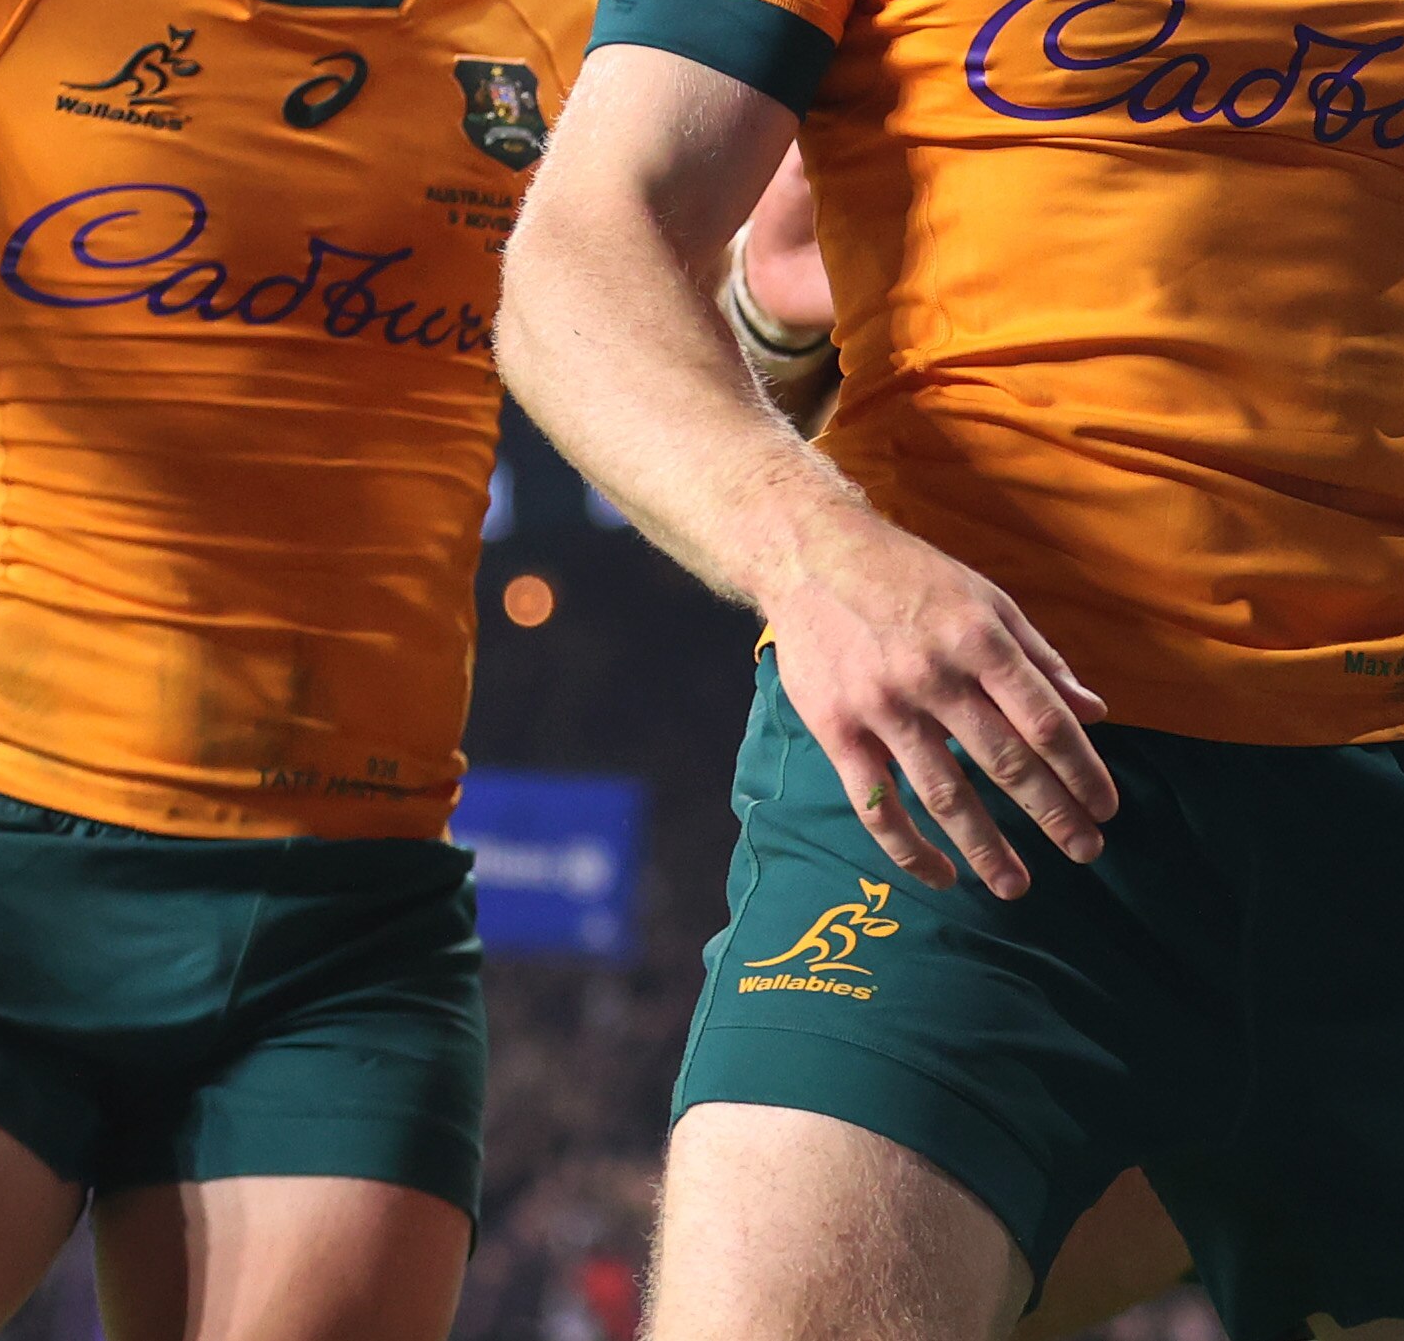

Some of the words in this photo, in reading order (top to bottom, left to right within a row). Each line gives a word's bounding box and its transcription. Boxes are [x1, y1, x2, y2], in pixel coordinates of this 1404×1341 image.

[56, 94, 183, 131] Wallabies
[1345, 650, 1391, 676] Max
[738, 973, 873, 1001] Wallabies
